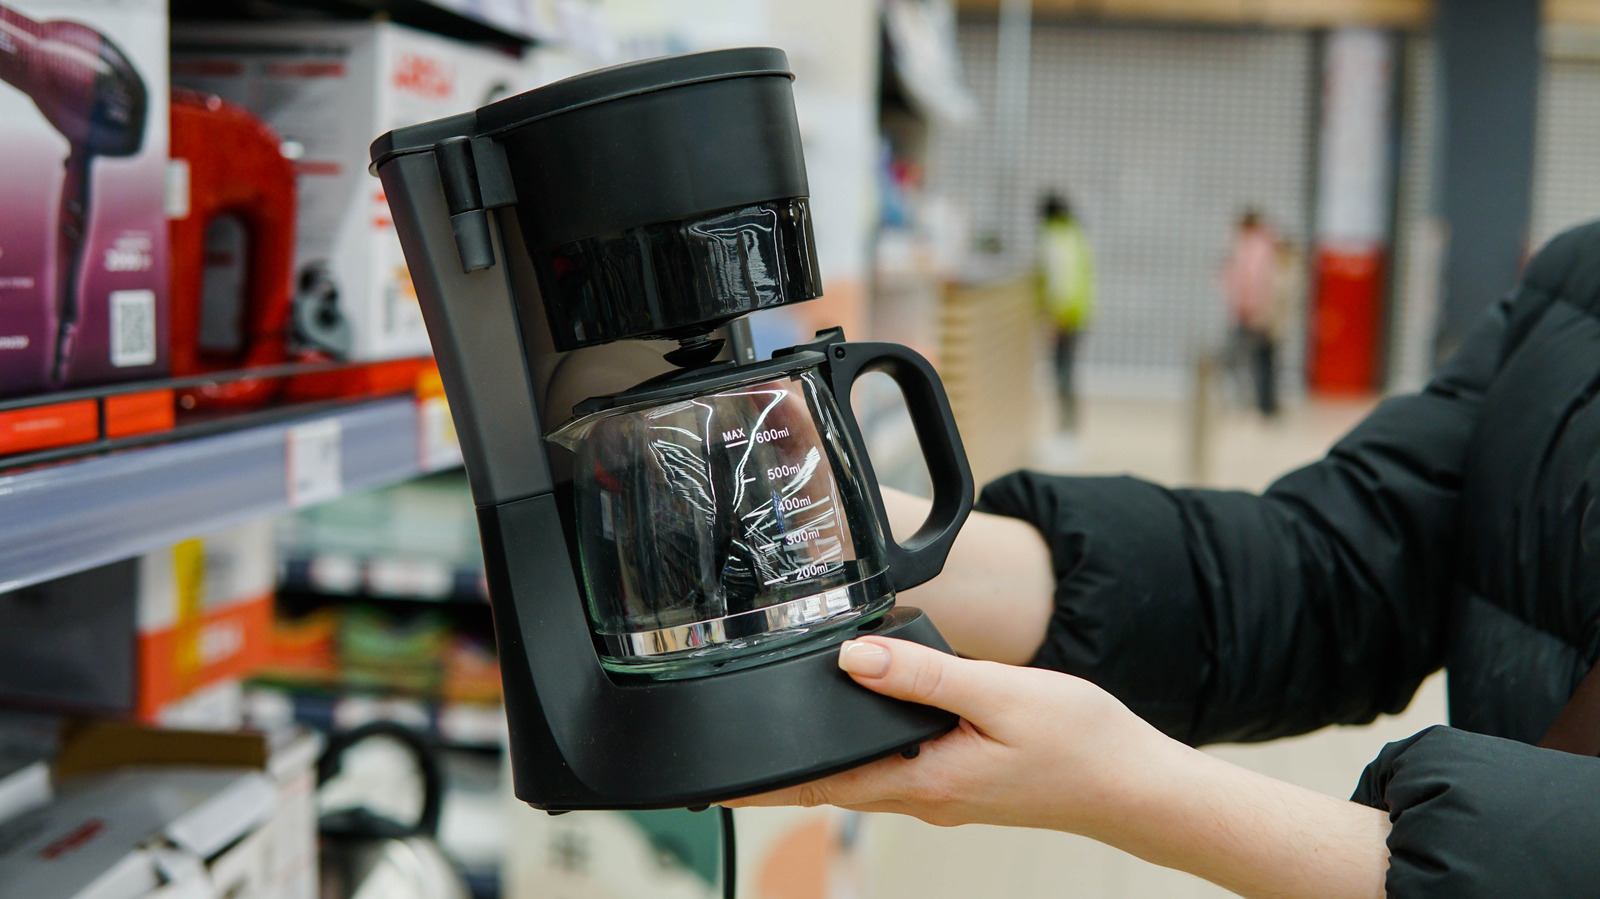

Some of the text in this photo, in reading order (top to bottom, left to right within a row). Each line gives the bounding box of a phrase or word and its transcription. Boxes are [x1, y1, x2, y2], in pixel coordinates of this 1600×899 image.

[722, 427, 790, 444] MAX 600ml
[767, 463, 800, 481] 500ml
[778, 495, 812, 512] 400ml
[785, 528, 820, 546] 300ml
[796, 563, 828, 581] 200ml
